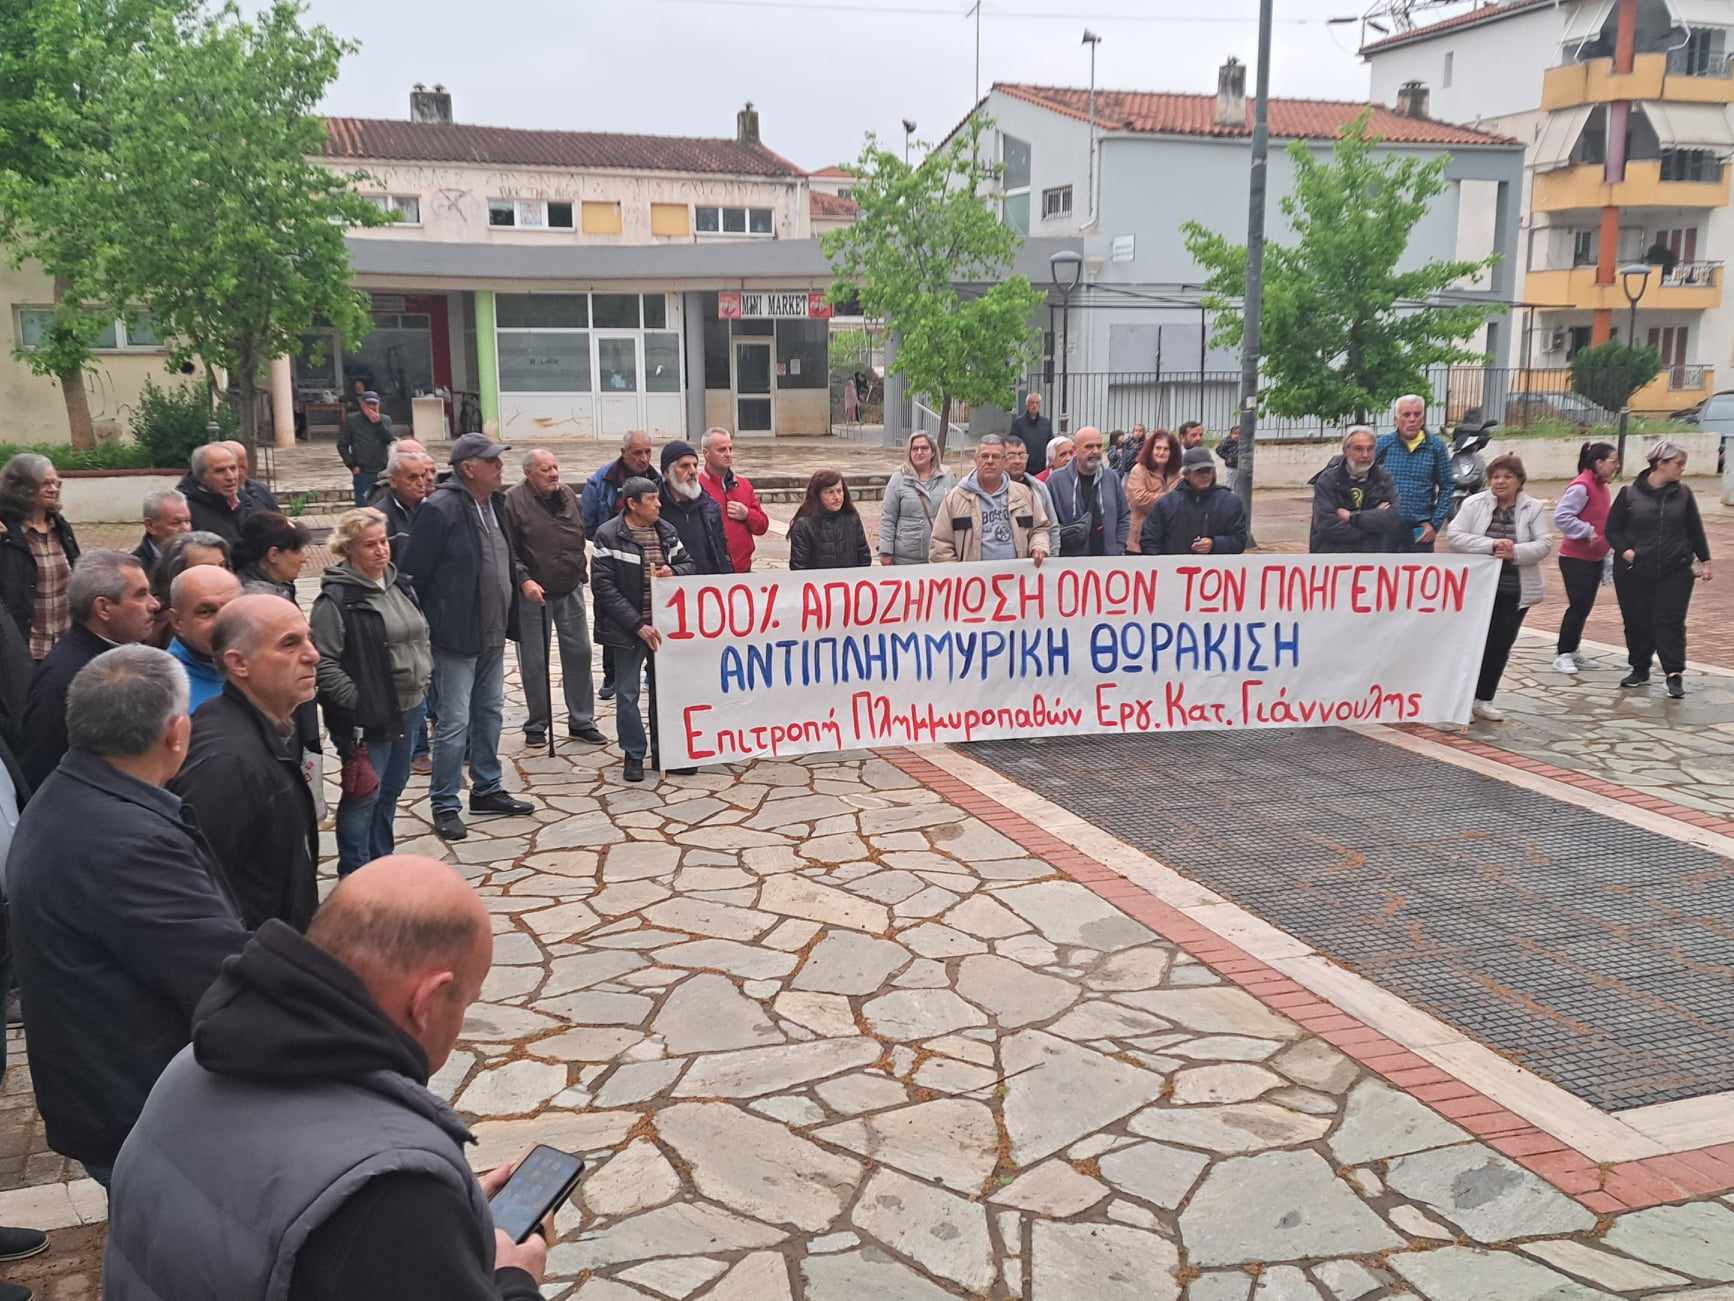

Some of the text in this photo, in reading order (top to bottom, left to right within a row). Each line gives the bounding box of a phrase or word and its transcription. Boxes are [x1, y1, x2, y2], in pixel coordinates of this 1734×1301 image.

[742, 295, 762, 315] MINI
[768, 294, 807, 315] MARKET
[667, 565, 1469, 640] 100% ΑΠΟΖΗΜΙΩΣΗ ΟΛΩΝ ΤΩΝ ΠΛΗΓΕΝΤΩΝ
[721, 622, 1299, 691] ΑΝΤΙΠΛΗΜΜΥΡΙΚΗ ΘΩΡΑΚΙΣΗ
[684, 680, 1420, 760] Επιτροπή Πλημμυροπαθών Εργ. Κατ. Γιάννουλης
